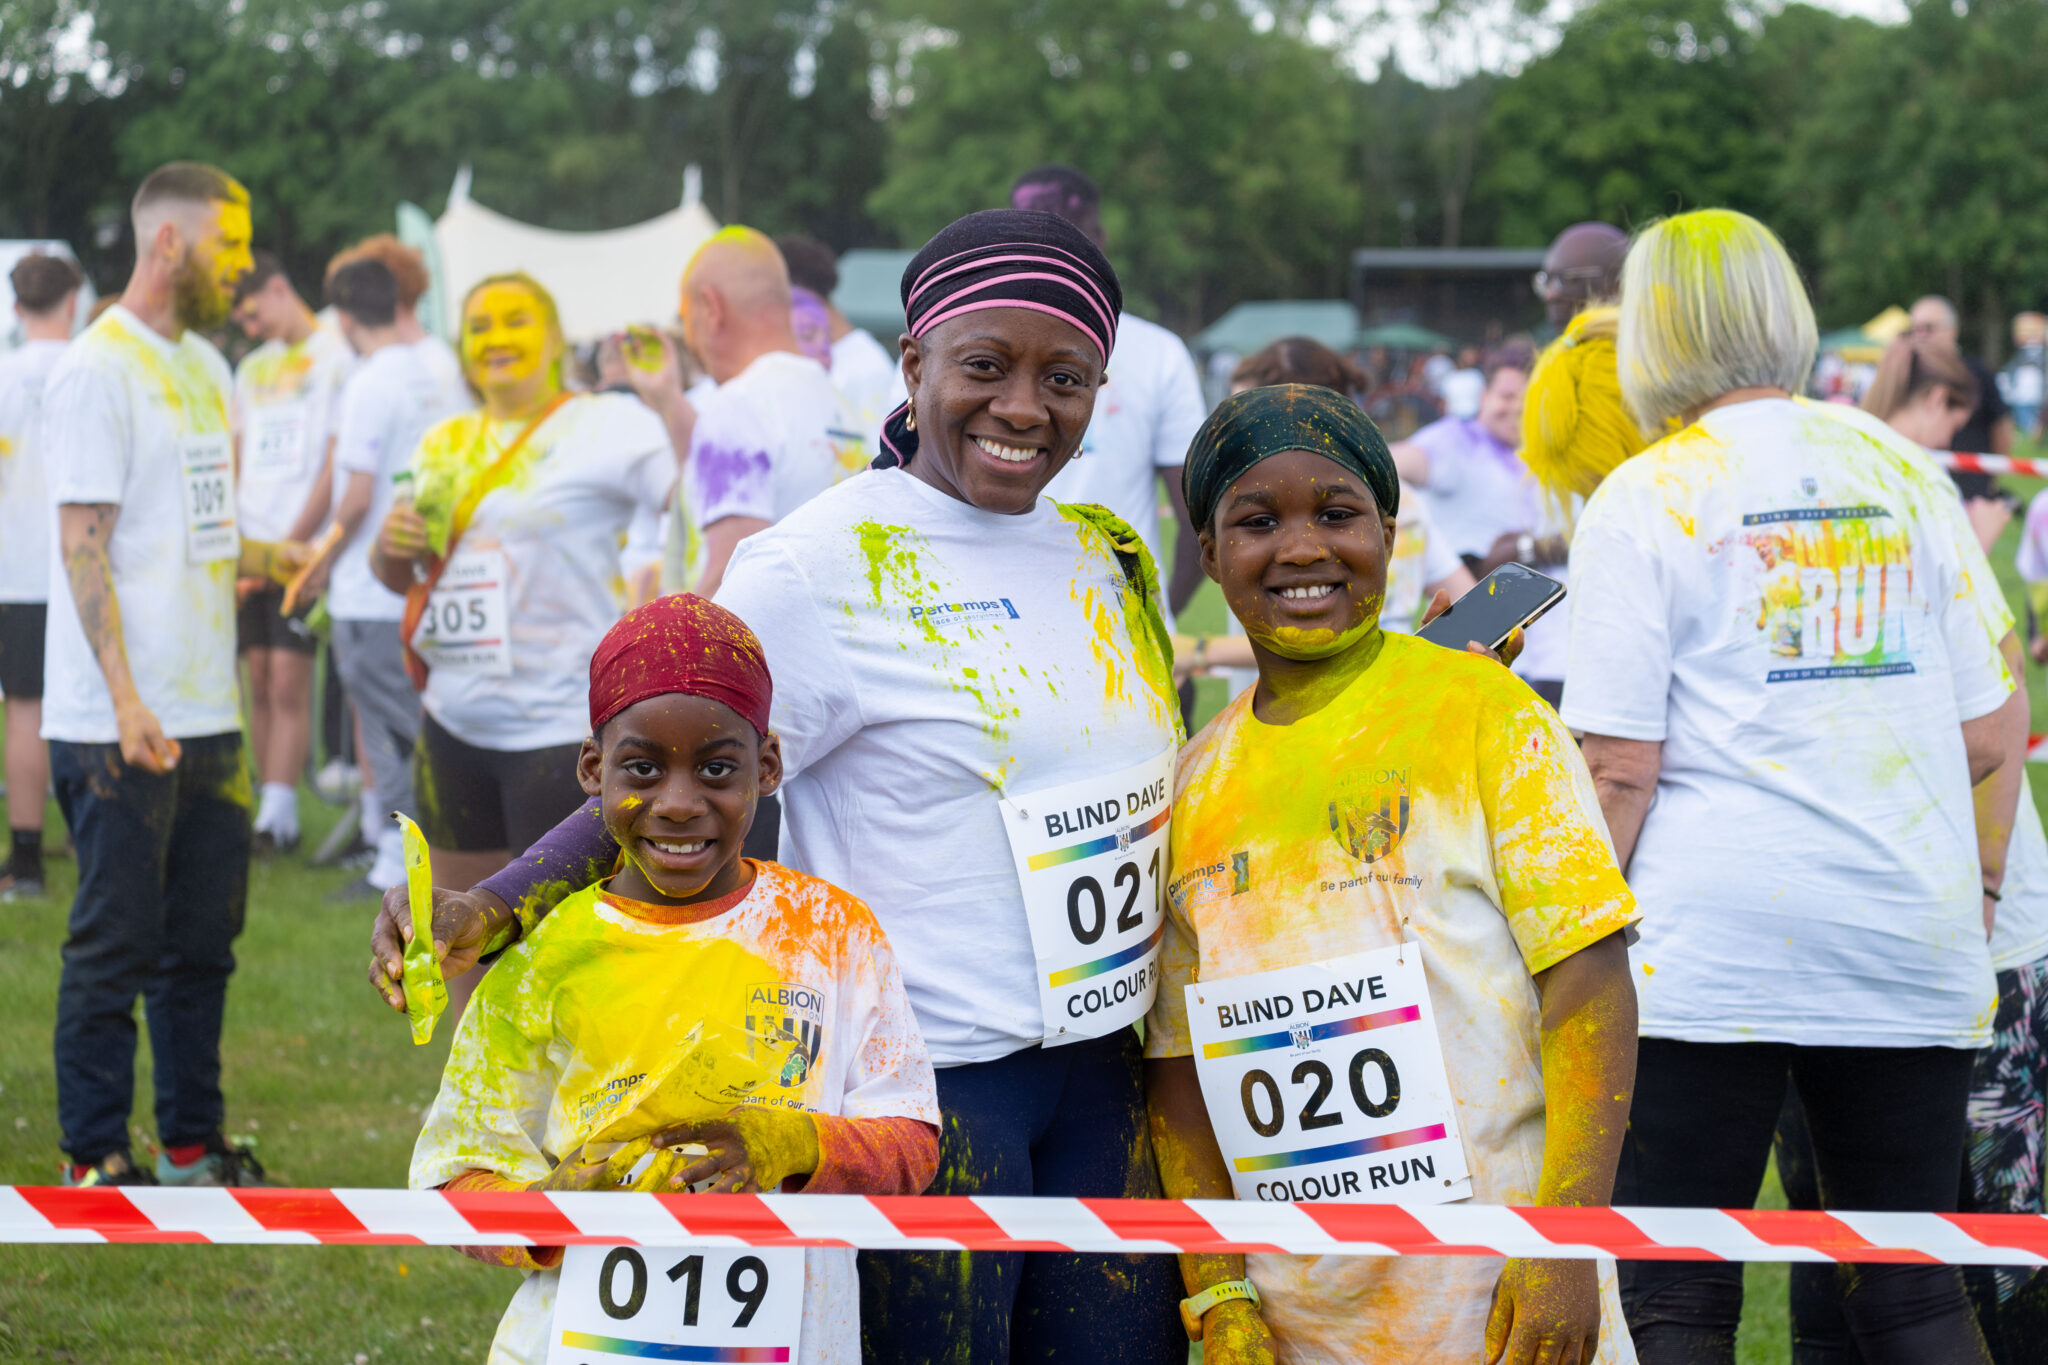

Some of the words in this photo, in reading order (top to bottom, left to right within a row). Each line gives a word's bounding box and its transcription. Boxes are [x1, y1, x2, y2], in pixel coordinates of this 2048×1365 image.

[190, 479, 225, 515] 309
[423, 598, 487, 634] 305
[910, 601, 1000, 619] Pertmps
[1045, 799, 1121, 838] BLIND
[1127, 777, 1166, 816] DAVE
[1066, 846, 1161, 945] 021
[1320, 881, 1336, 893] Be
[1339, 875, 1363, 891] part
[1363, 871, 1373, 885] of
[1393, 872, 1423, 889] family
[751, 988, 821, 1013] ALBION
[1067, 967, 1146, 1018] COLOUR
[1217, 995, 1294, 1028] BLIND
[1302, 975, 1387, 1013] DAVE
[770, 1095, 784, 1106] of
[787, 1099, 804, 1110] our
[1240, 1048, 1401, 1138] 020
[1256, 1171, 1362, 1201] COLOUR
[1369, 1155, 1436, 1190] RUN
[598, 1246, 769, 1328] 019
